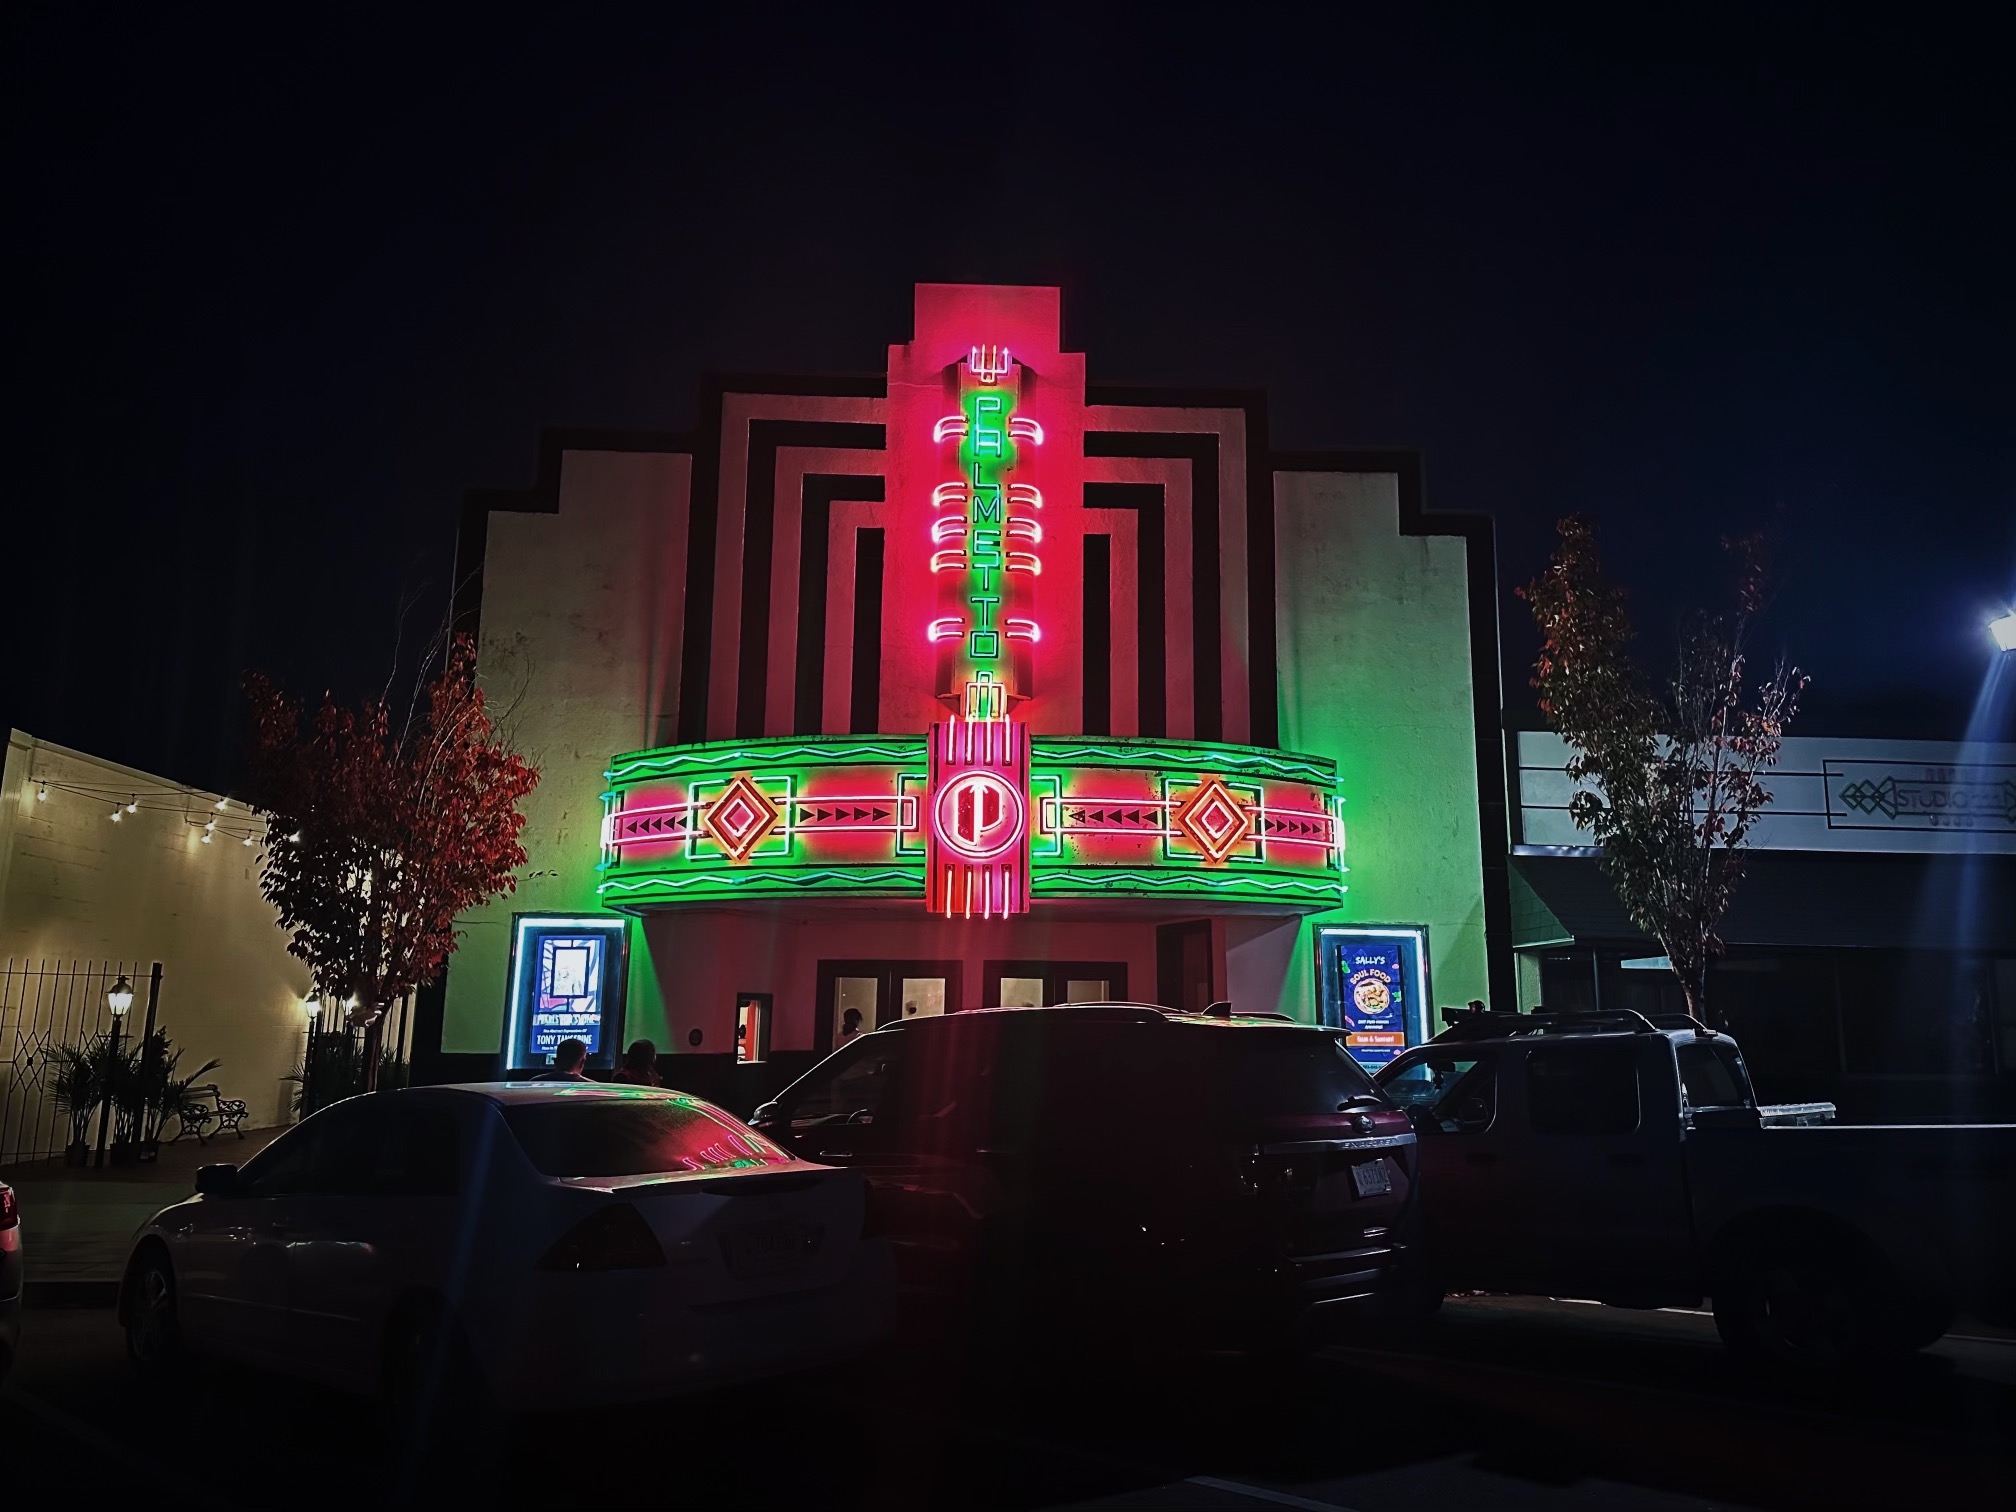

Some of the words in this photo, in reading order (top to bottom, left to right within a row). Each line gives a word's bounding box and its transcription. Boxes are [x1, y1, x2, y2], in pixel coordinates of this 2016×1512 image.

[970, 396, 1001, 659] PALMETTO
[1897, 789, 1968, 808] STUDIO
[1355, 956, 1386, 965] SALLY'S
[1350, 969, 1369, 985] SOUL
[1370, 969, 1391, 983] FOOD
[537, 1035, 556, 1045] TONY
